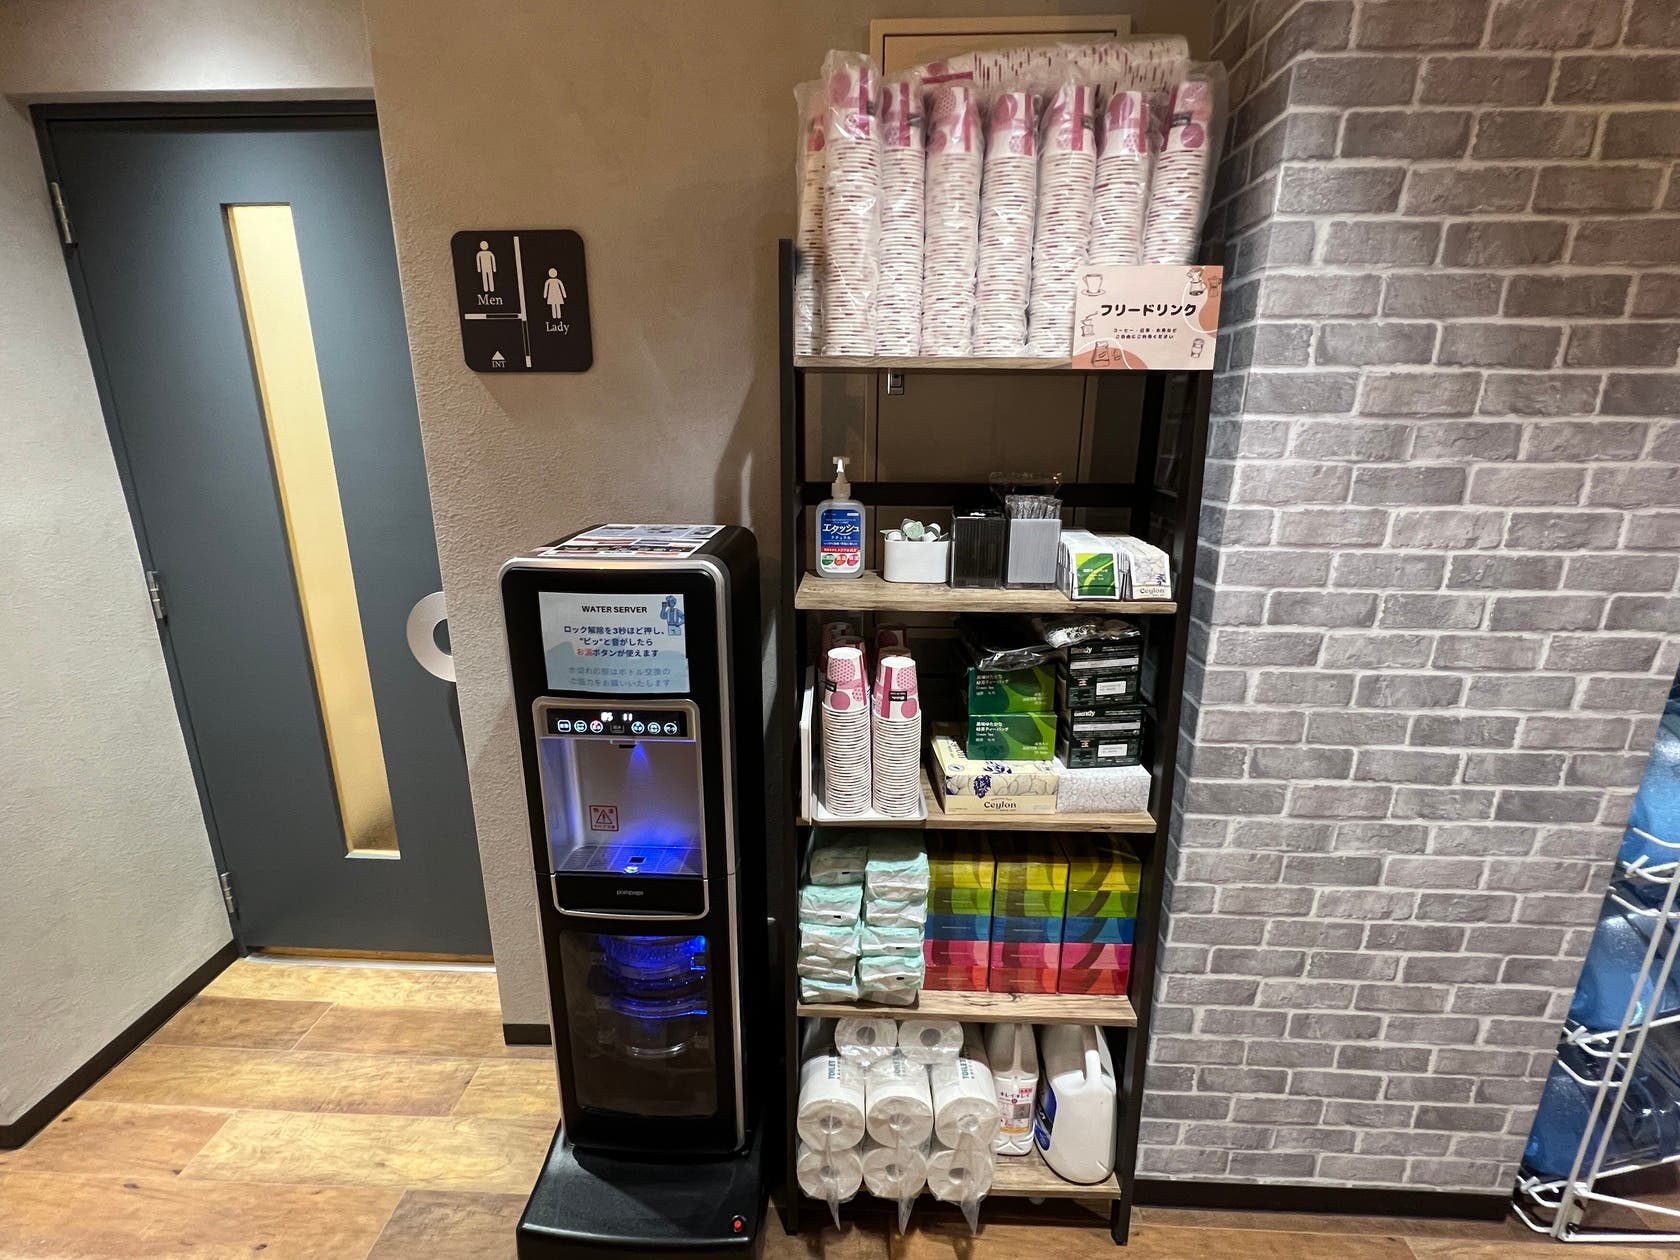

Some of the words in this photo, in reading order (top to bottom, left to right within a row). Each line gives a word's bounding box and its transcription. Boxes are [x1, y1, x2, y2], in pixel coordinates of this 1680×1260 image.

[477, 294, 503, 306] Men
[1100, 303, 1197, 317] フリードリンク
[546, 321, 570, 335] Lady
[491, 360, 507, 369] INT
[822, 523, 860, 535] エタッシュ
[581, 605, 612, 614] WATER
[613, 605, 648, 614] SERVER
[983, 801, 1017, 809] Ceylon
[827, 1060, 836, 1080] TOILET
[961, 1059, 970, 1080] TOILET
